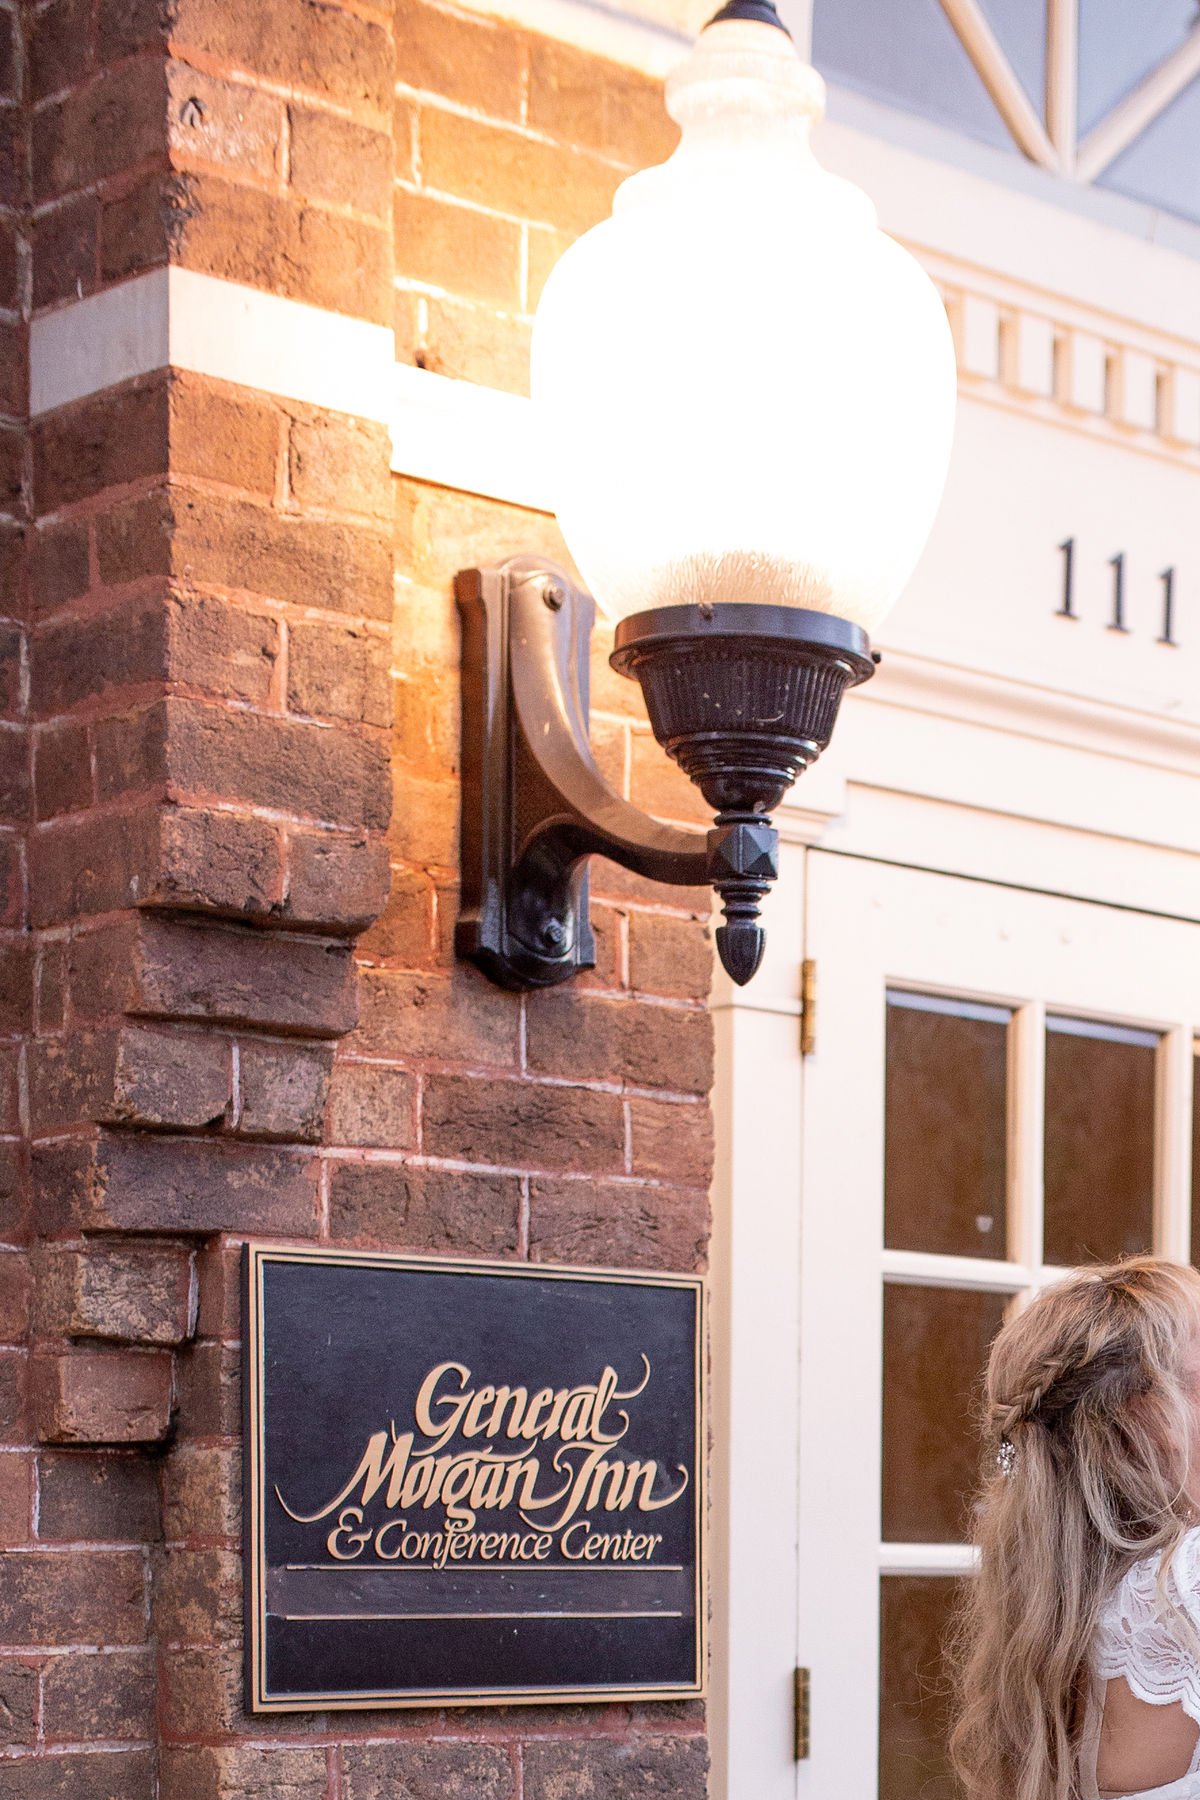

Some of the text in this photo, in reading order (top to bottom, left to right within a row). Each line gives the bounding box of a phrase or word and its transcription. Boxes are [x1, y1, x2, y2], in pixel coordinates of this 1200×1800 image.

[1054, 536, 1179, 649] 111
[411, 1353, 651, 1457] General
[274, 1420, 689, 1533] Morgan Inn
[326, 1507, 663, 1569] & Conference Center
